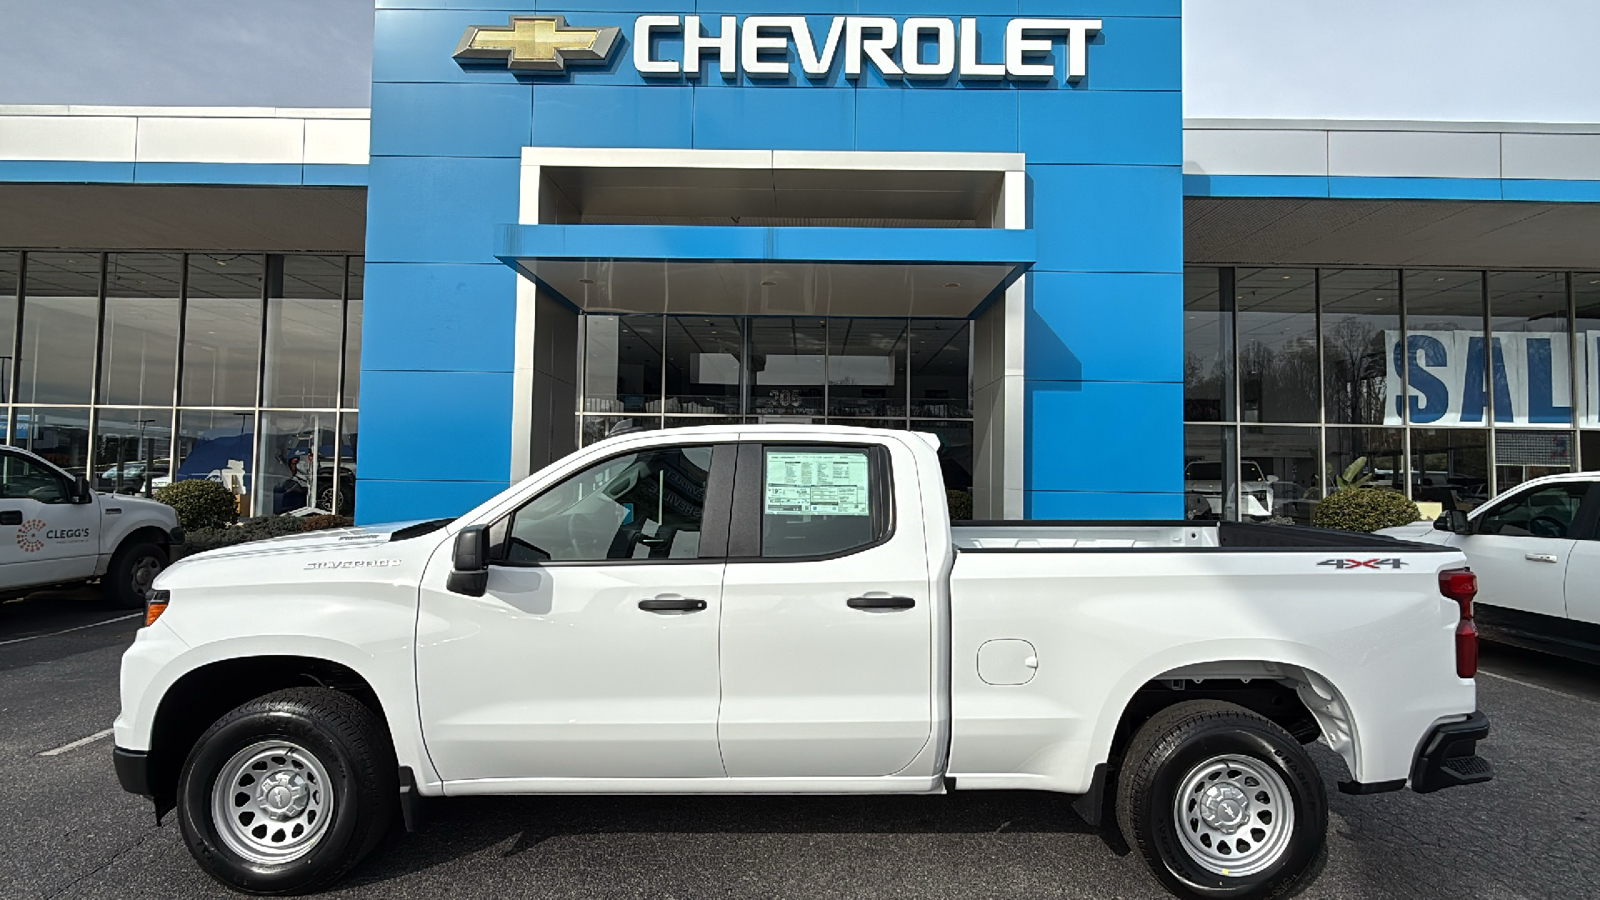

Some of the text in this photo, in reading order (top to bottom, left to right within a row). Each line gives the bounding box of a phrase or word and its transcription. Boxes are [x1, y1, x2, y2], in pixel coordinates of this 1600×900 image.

[633, 15, 1102, 82] CHEVROLET
[1394, 334, 1600, 423] SAL
[46, 528, 90, 539] CLEGG'S
[303, 559, 402, 571] SILVERADO
